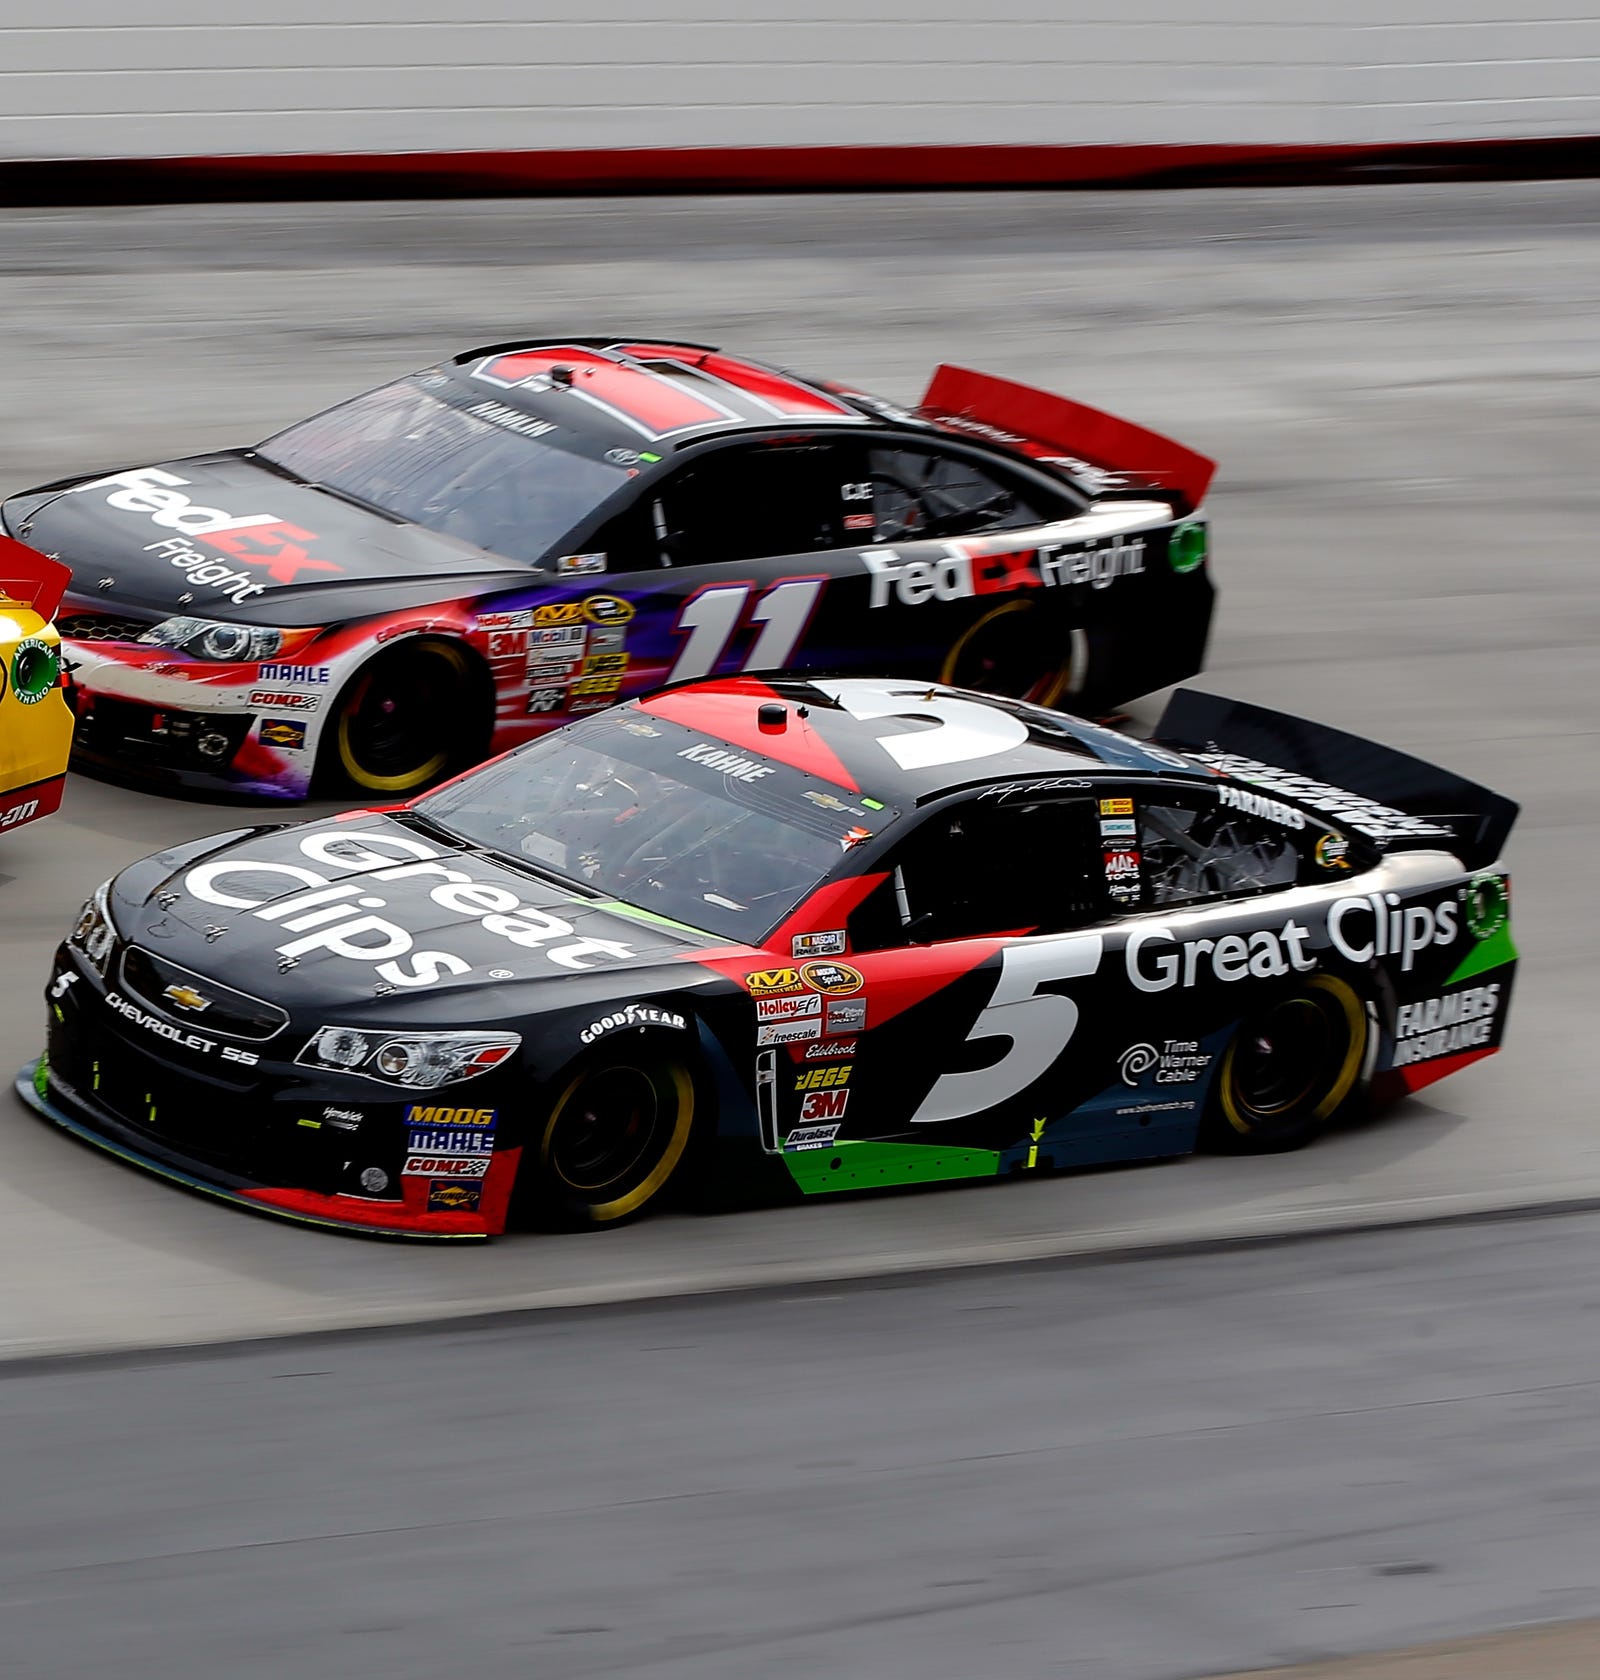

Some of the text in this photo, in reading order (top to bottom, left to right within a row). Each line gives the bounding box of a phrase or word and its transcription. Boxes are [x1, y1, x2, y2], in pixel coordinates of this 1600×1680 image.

[467, 400, 559, 438] HAMLIN
[72, 467, 345, 584] FedEx
[142, 537, 266, 605] Freight
[858, 545, 1045, 608] FedEx
[1039, 536, 1146, 590] Freight
[665, 575, 831, 685] 11
[14, 639, 54, 661] AMERICAN
[14, 681, 54, 704] ETHANOL
[258, 664, 330, 683] MAHLE
[806, 679, 1029, 770] 5
[676, 743, 776, 783] KAHNE
[1217, 784, 1305, 830] FARMERS
[300, 831, 636, 970] Great
[183, 861, 473, 987] Clips
[1125, 919, 1317, 993] Great
[1327, 893, 1457, 972] Clips
[51, 971, 79, 998] 5
[580, 1003, 687, 1044] GOODYEAR
[758, 999, 797, 1016] Holley
[1396, 984, 1500, 1038] FARMERS
[105, 992, 260, 1066] CHEVROLET SS
[774, 1029, 817, 1043] freescale
[909, 934, 1103, 1122] 5
[1164, 1039, 1198, 1053] Time
[1392, 1017, 1493, 1068] INSURANCE
[805, 1041, 857, 1058] Edelbrock
[1160, 1055, 1212, 1068] Warner
[795, 1066, 853, 1090] JEGS
[1156, 1068, 1197, 1083] Cable
[407, 1105, 495, 1125] MOOG
[802, 1089, 848, 1119] 3M
[409, 1131, 495, 1152] MAHLE
[788, 1126, 837, 1143] Duralast
